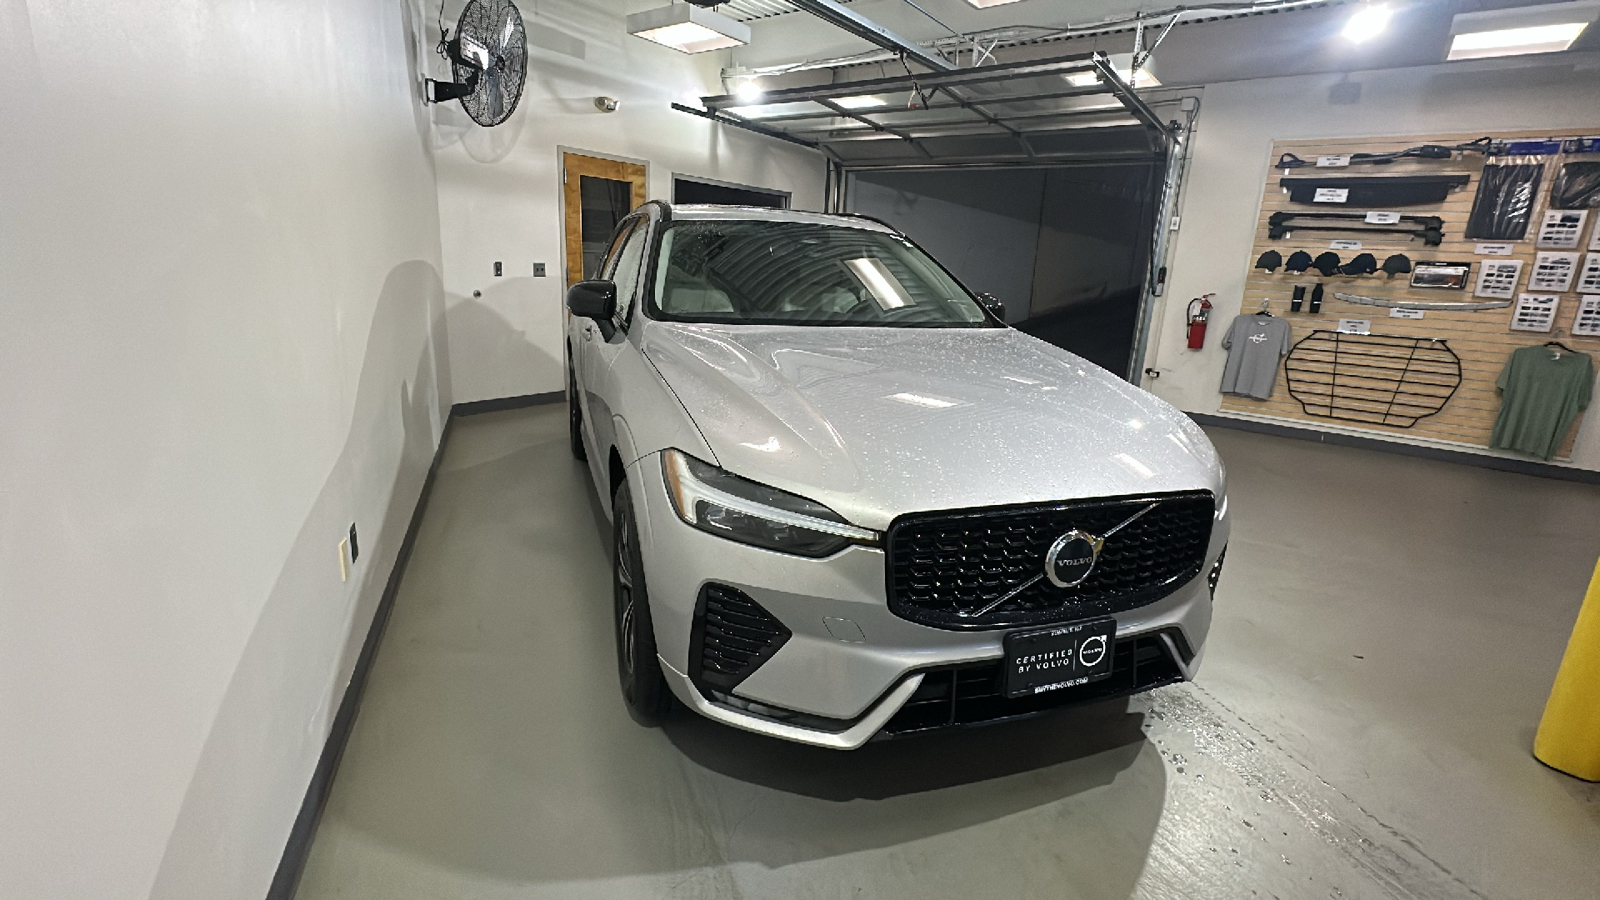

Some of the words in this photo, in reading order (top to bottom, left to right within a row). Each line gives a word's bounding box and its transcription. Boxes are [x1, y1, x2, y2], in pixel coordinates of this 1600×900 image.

[1057, 557, 1092, 566] VOLVO
[1016, 649, 1073, 665] CERTIFIED
[1018, 665, 1031, 674] BY
[1036, 658, 1070, 670] VOLVO
